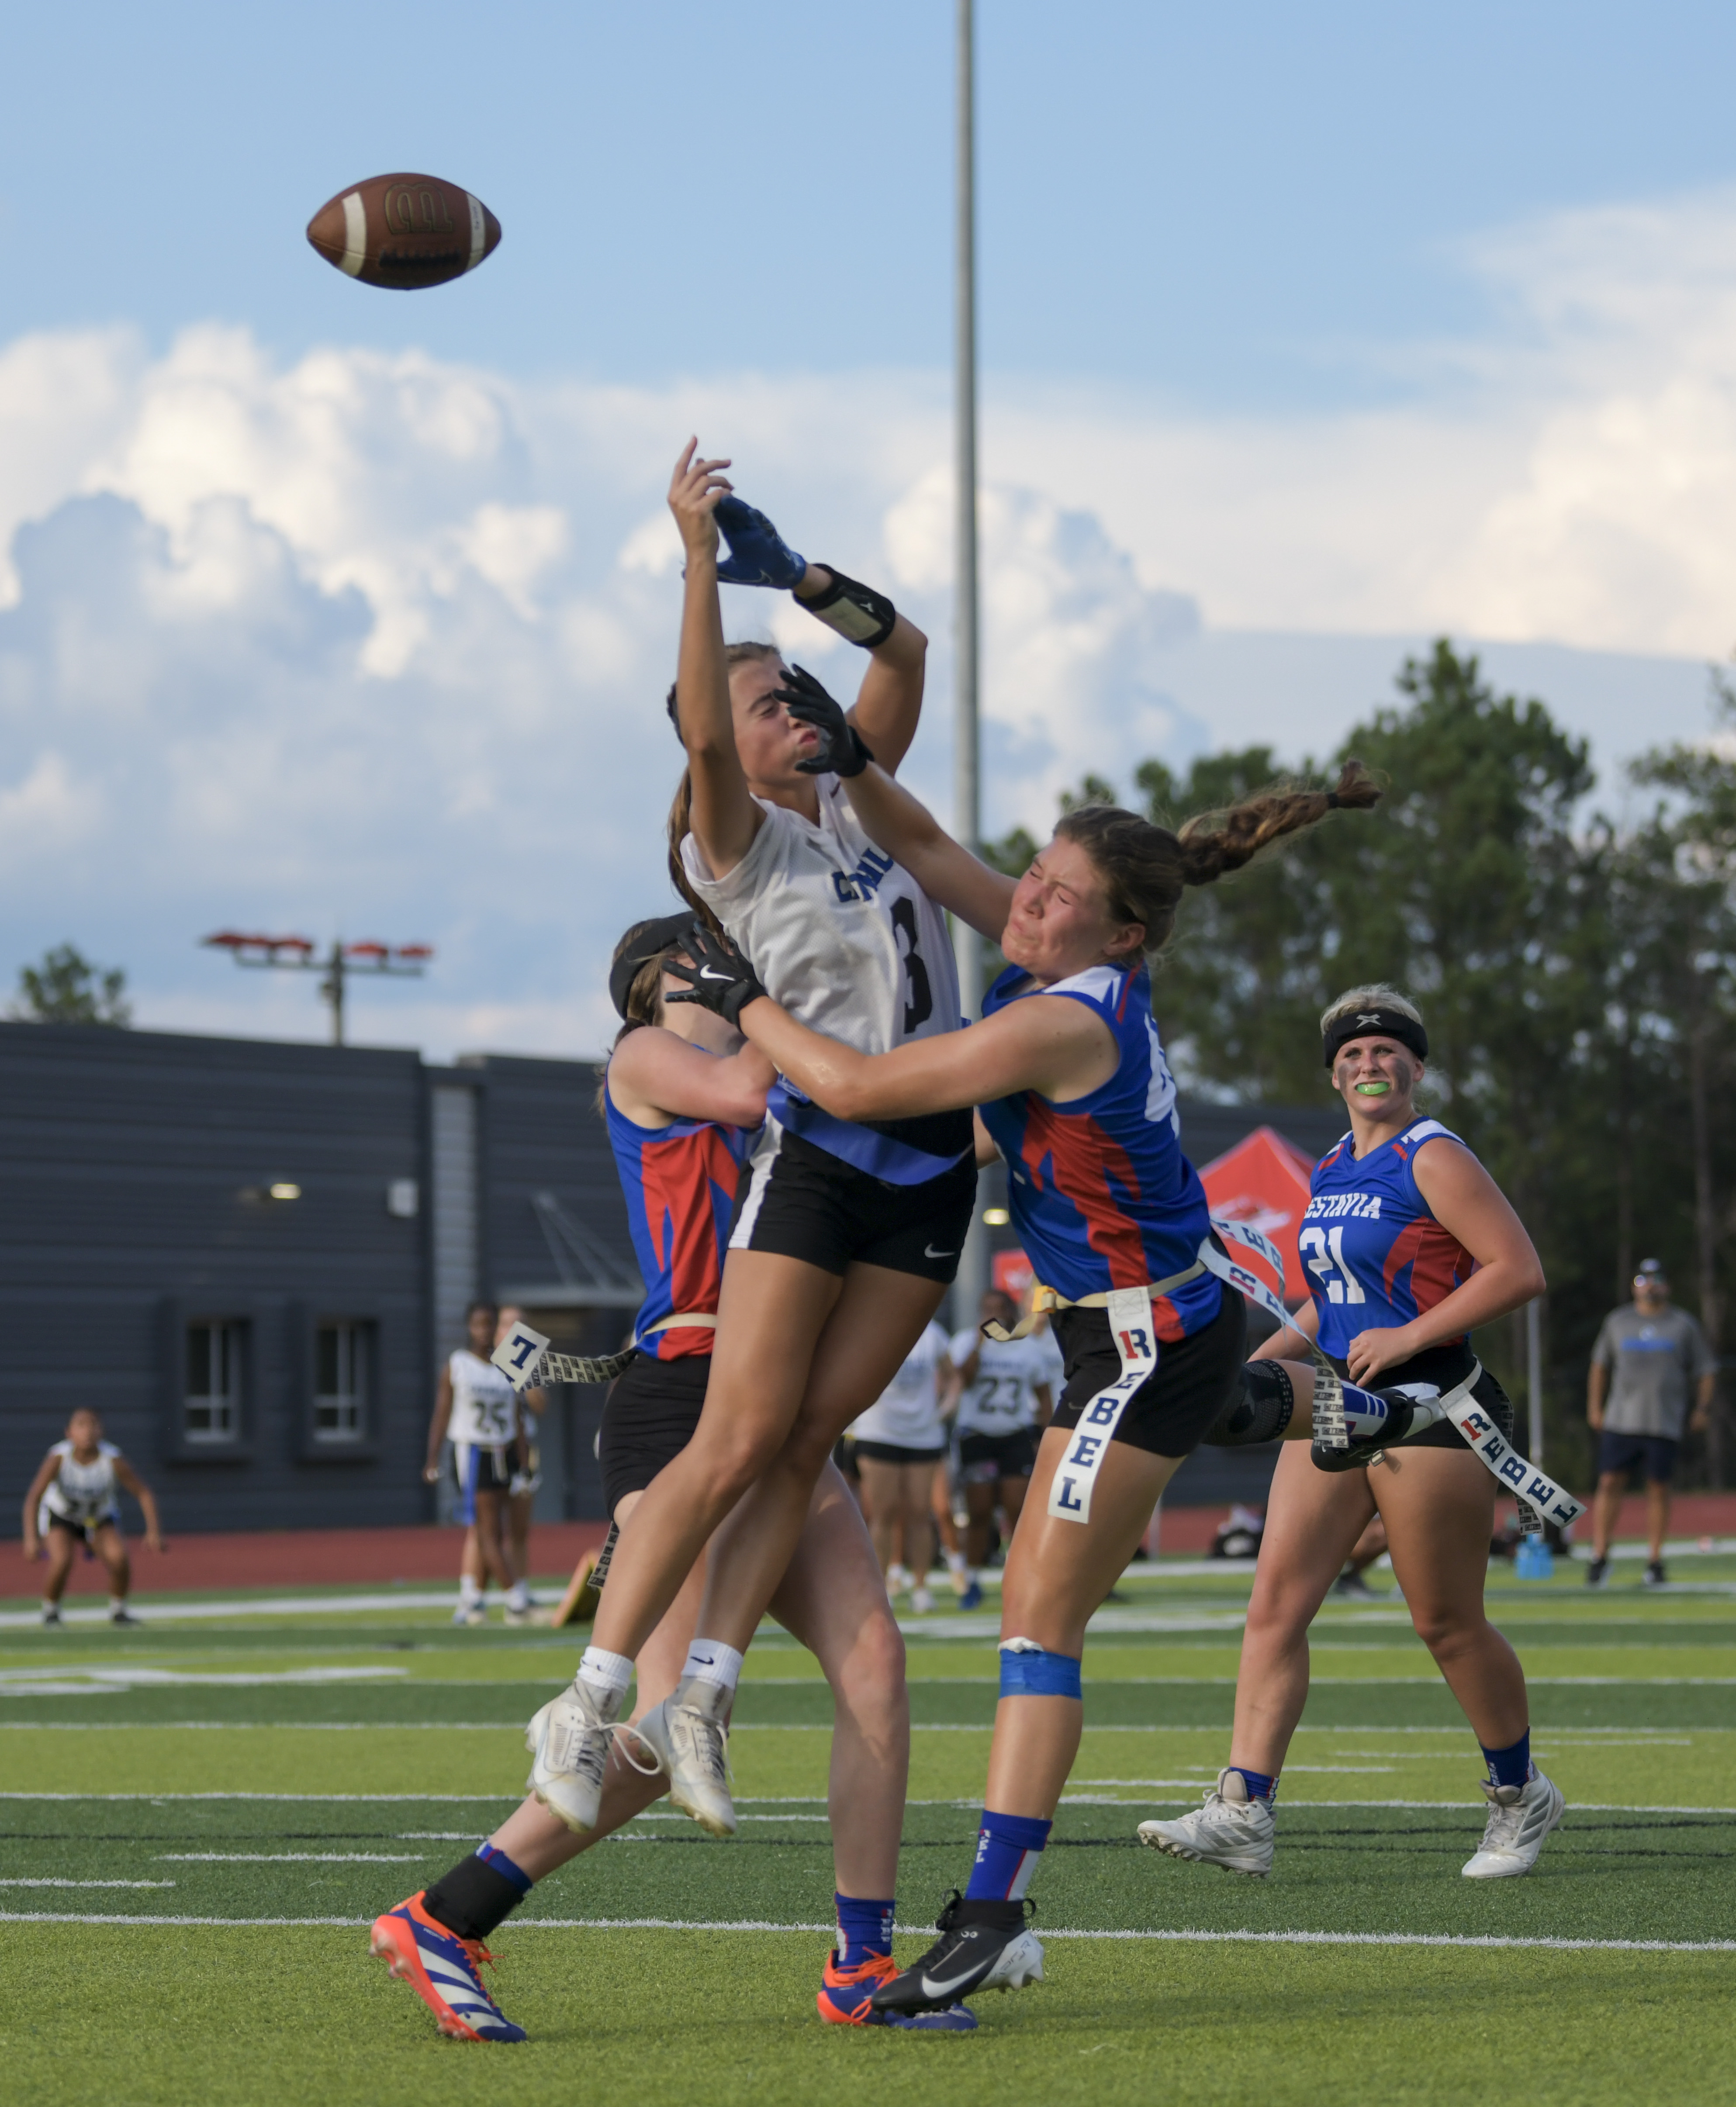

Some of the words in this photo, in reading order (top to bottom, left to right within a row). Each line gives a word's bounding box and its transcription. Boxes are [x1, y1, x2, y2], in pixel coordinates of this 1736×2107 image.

[1304, 1193, 1382, 1219] ESTAVIA
[1299, 1226, 1366, 1304] 21
[978, 1376, 1023, 1415] 23
[1058, 1328, 1152, 1511] REBEL
[1461, 1413, 1578, 1523] REBEL
